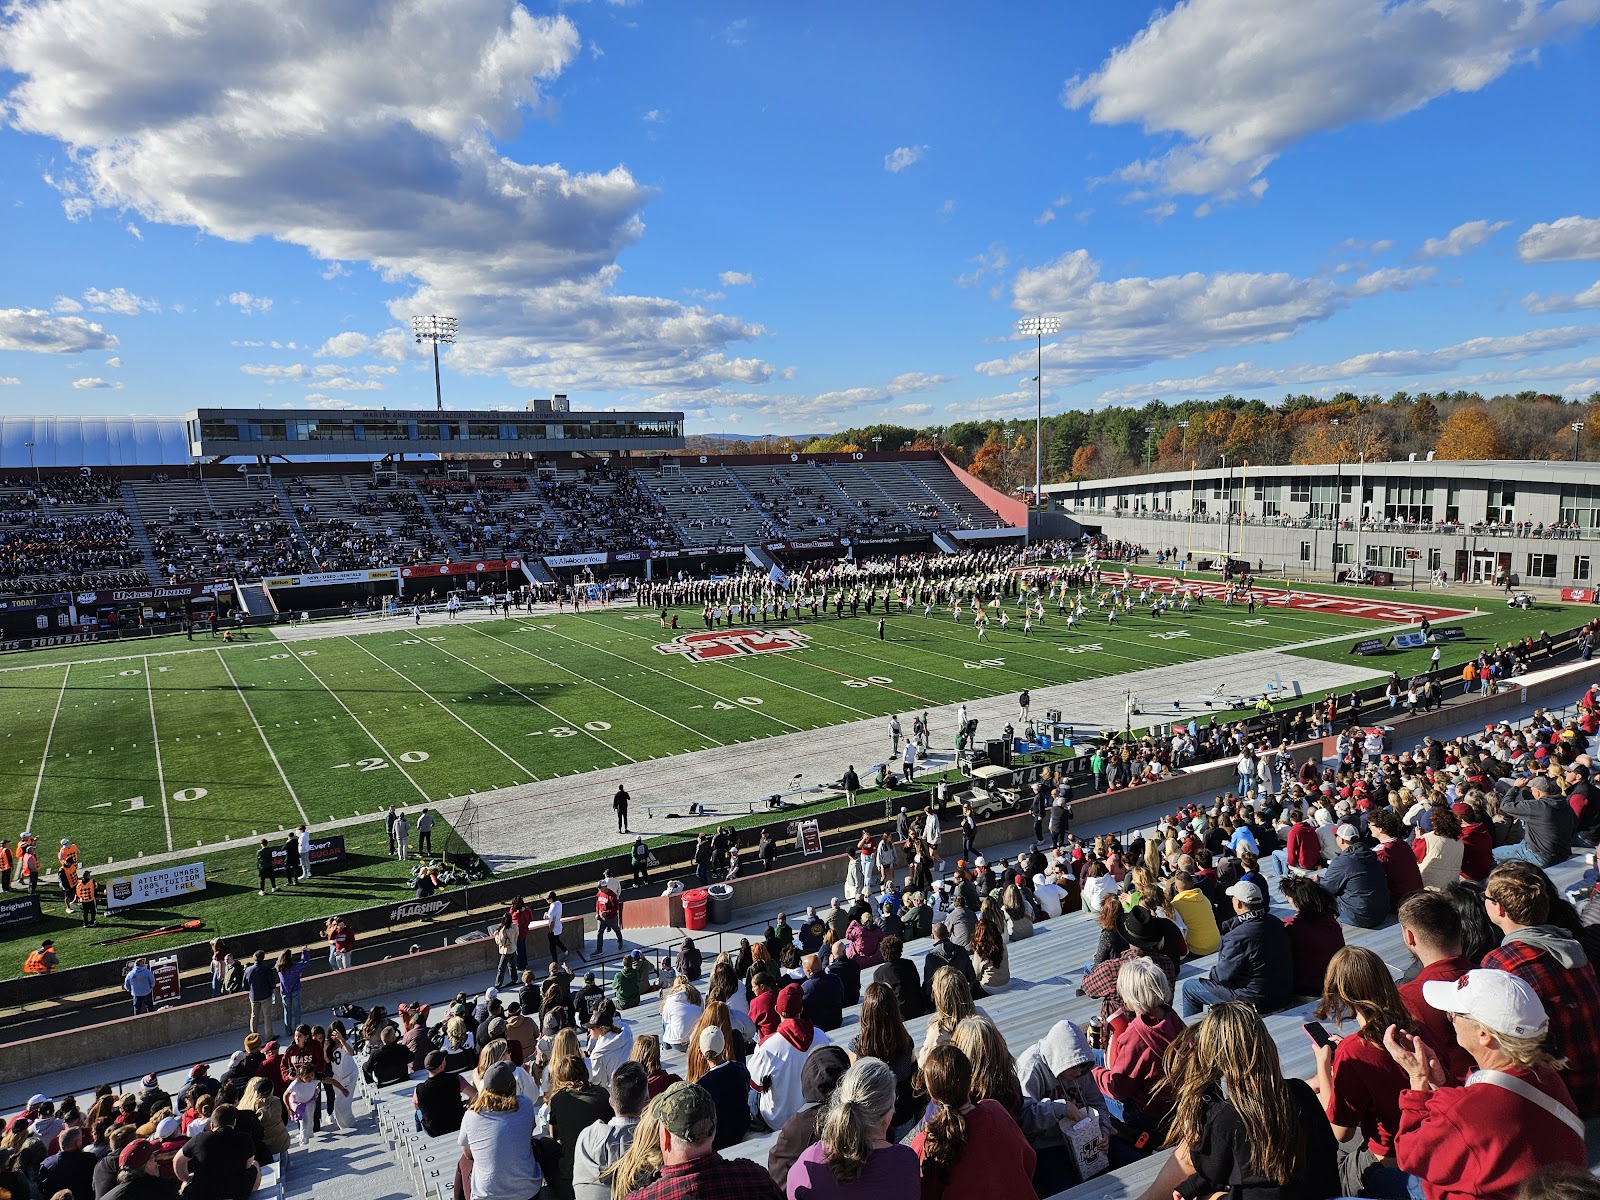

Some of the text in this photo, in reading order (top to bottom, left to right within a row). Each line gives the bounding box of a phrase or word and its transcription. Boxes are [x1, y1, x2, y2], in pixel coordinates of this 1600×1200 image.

[362, 411, 390, 419] MARTIN
[392, 411, 407, 419] AND
[409, 411, 440, 419] RICHARD
[442, 411, 477, 419] JACOBSON
[602, 457, 609, 466] 7
[699, 455, 707, 464] 8
[790, 453, 798, 462] 9
[851, 452, 863, 461] 10
[237, 463, 248, 473] 4
[373, 462, 382, 471] 5
[493, 459, 501, 468] 6
[80, 466, 92, 477] 3
[12, 599, 37, 608] TODAY!
[31, 633, 99, 648] FOOTBALL
[271, 841, 331, 858] Bes Ever?
[310, 847, 341, 859] SUGAR
[138, 867, 199, 885] ATTEND UMASS
[139, 873, 200, 892] 100% TUITION
[155, 886, 170, 895] FEE
[175, 882, 196, 891] FREE
[0, 901, 33, 912] Brigham
[390, 901, 443, 920] #FLAGSHIP
